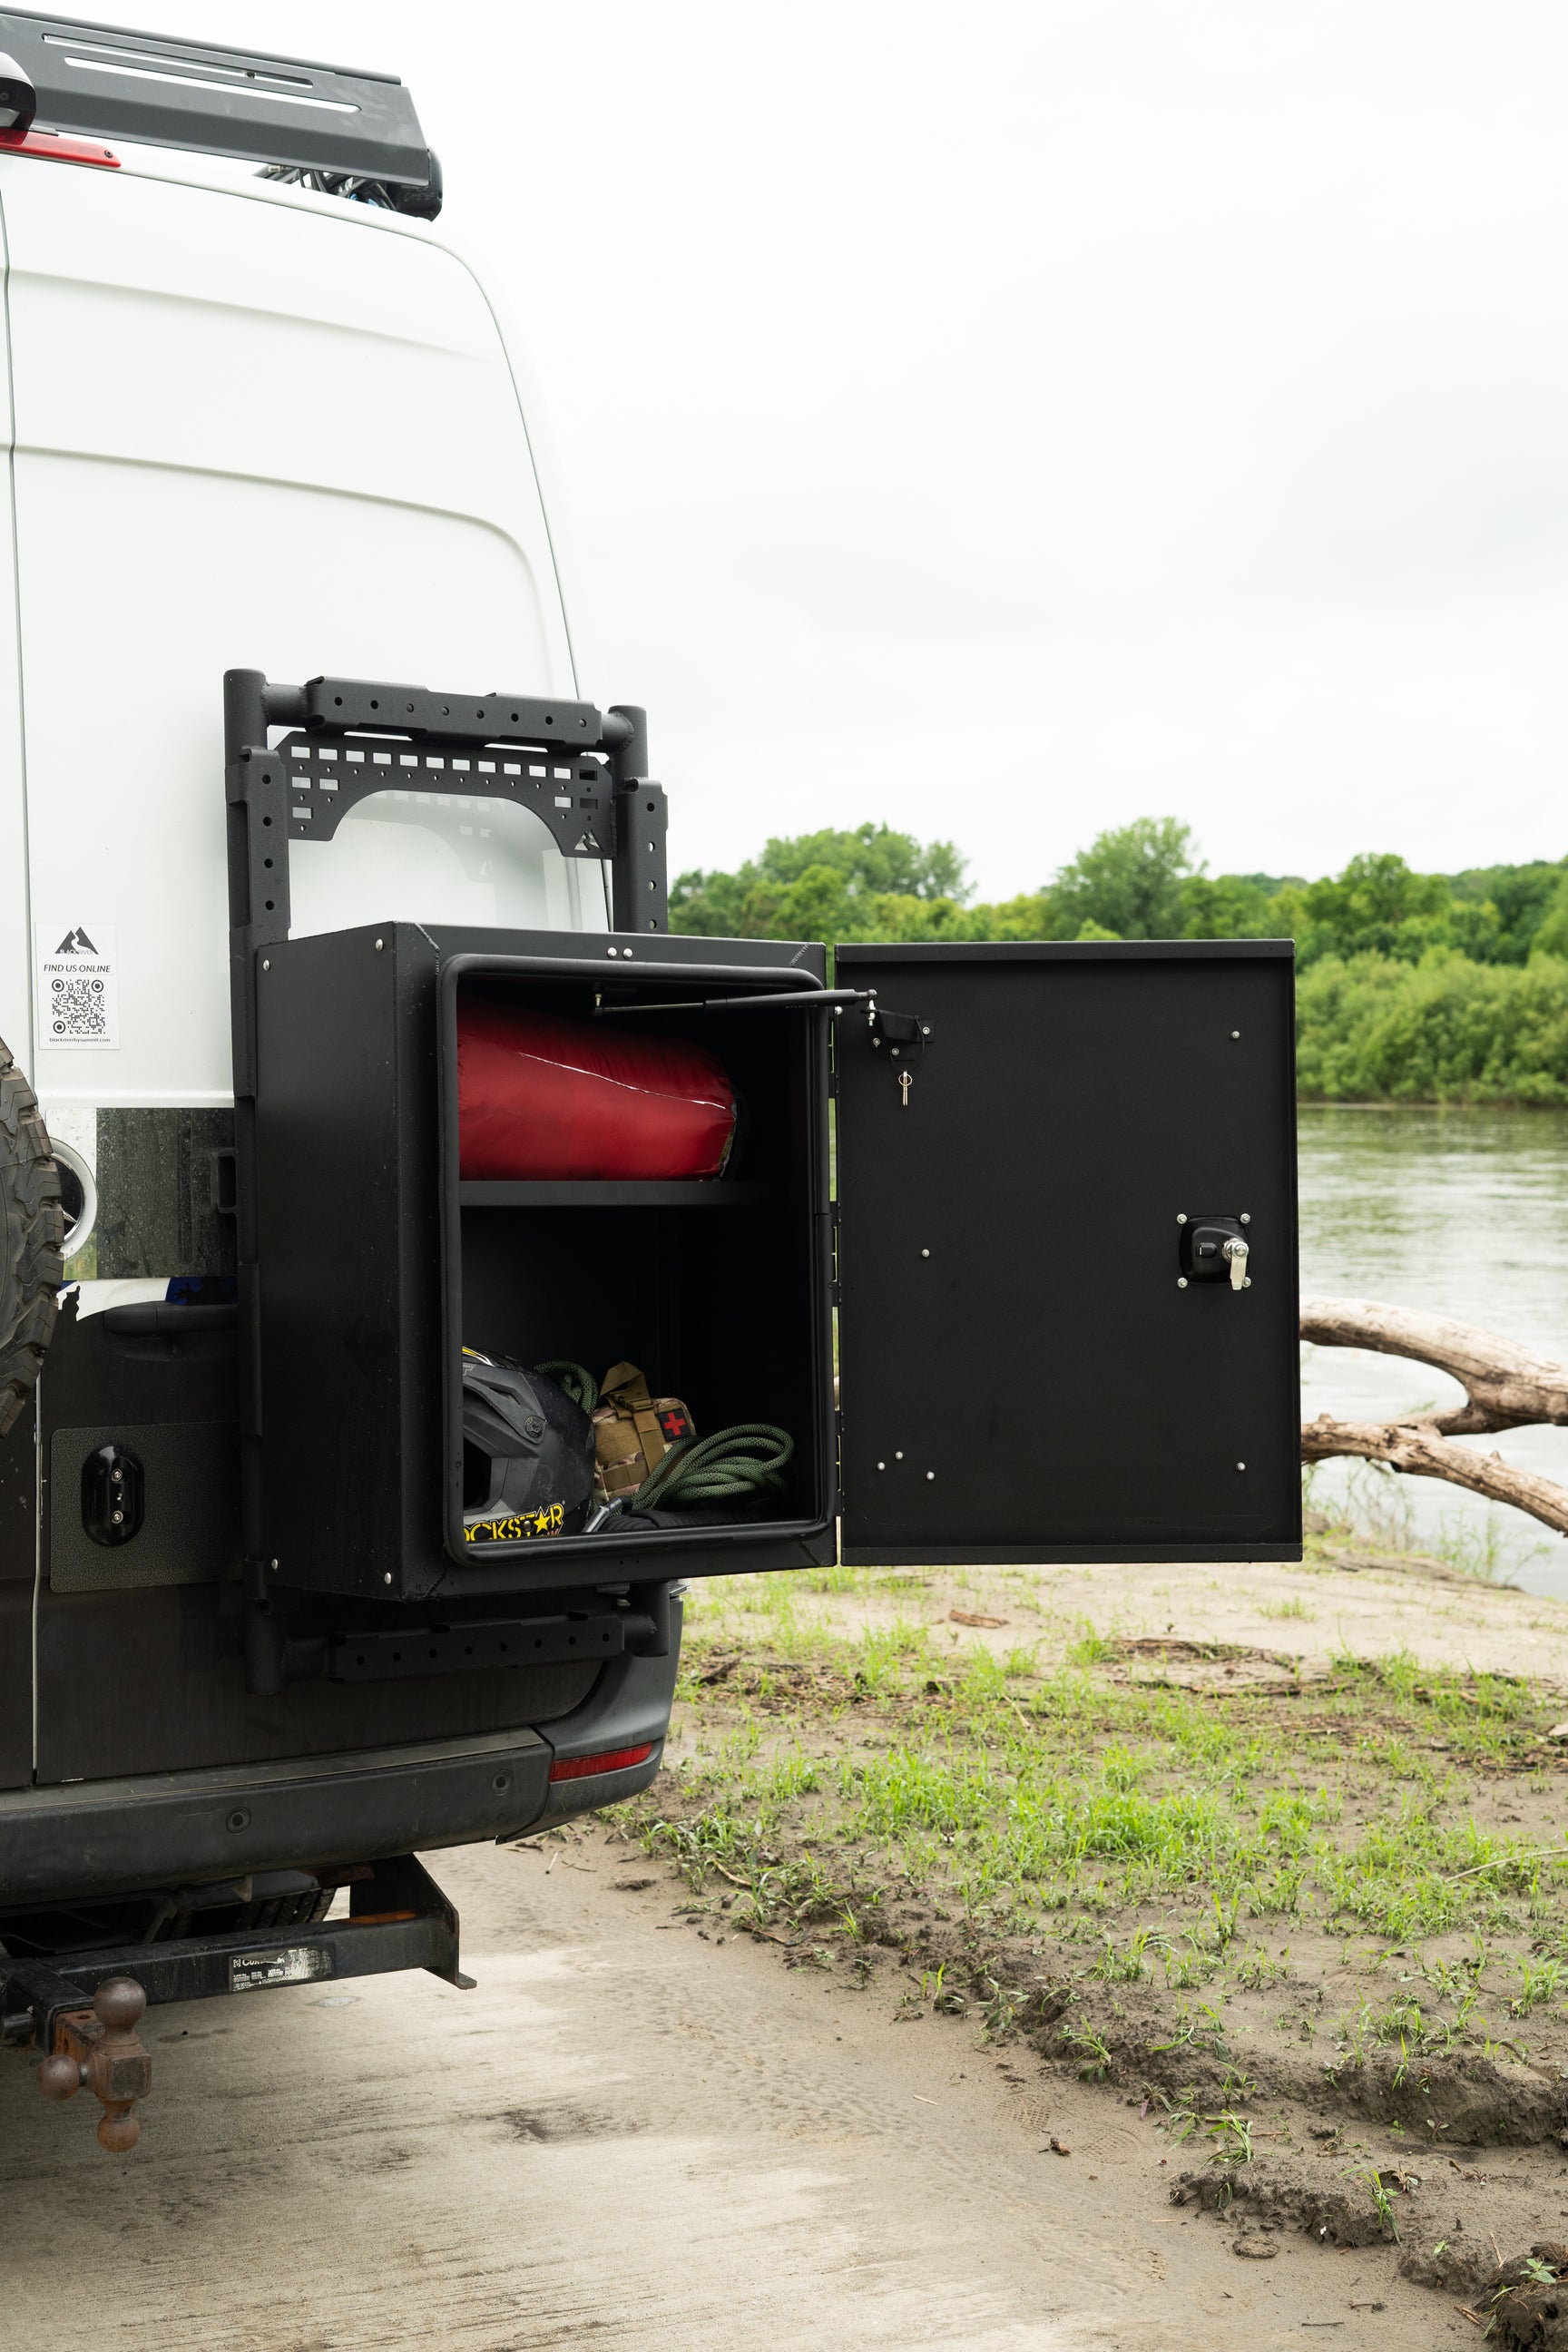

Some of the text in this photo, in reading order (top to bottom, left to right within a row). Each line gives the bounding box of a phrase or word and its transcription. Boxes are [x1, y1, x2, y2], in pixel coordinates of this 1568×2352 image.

[44, 964, 111, 973] FIND US ONLINE
